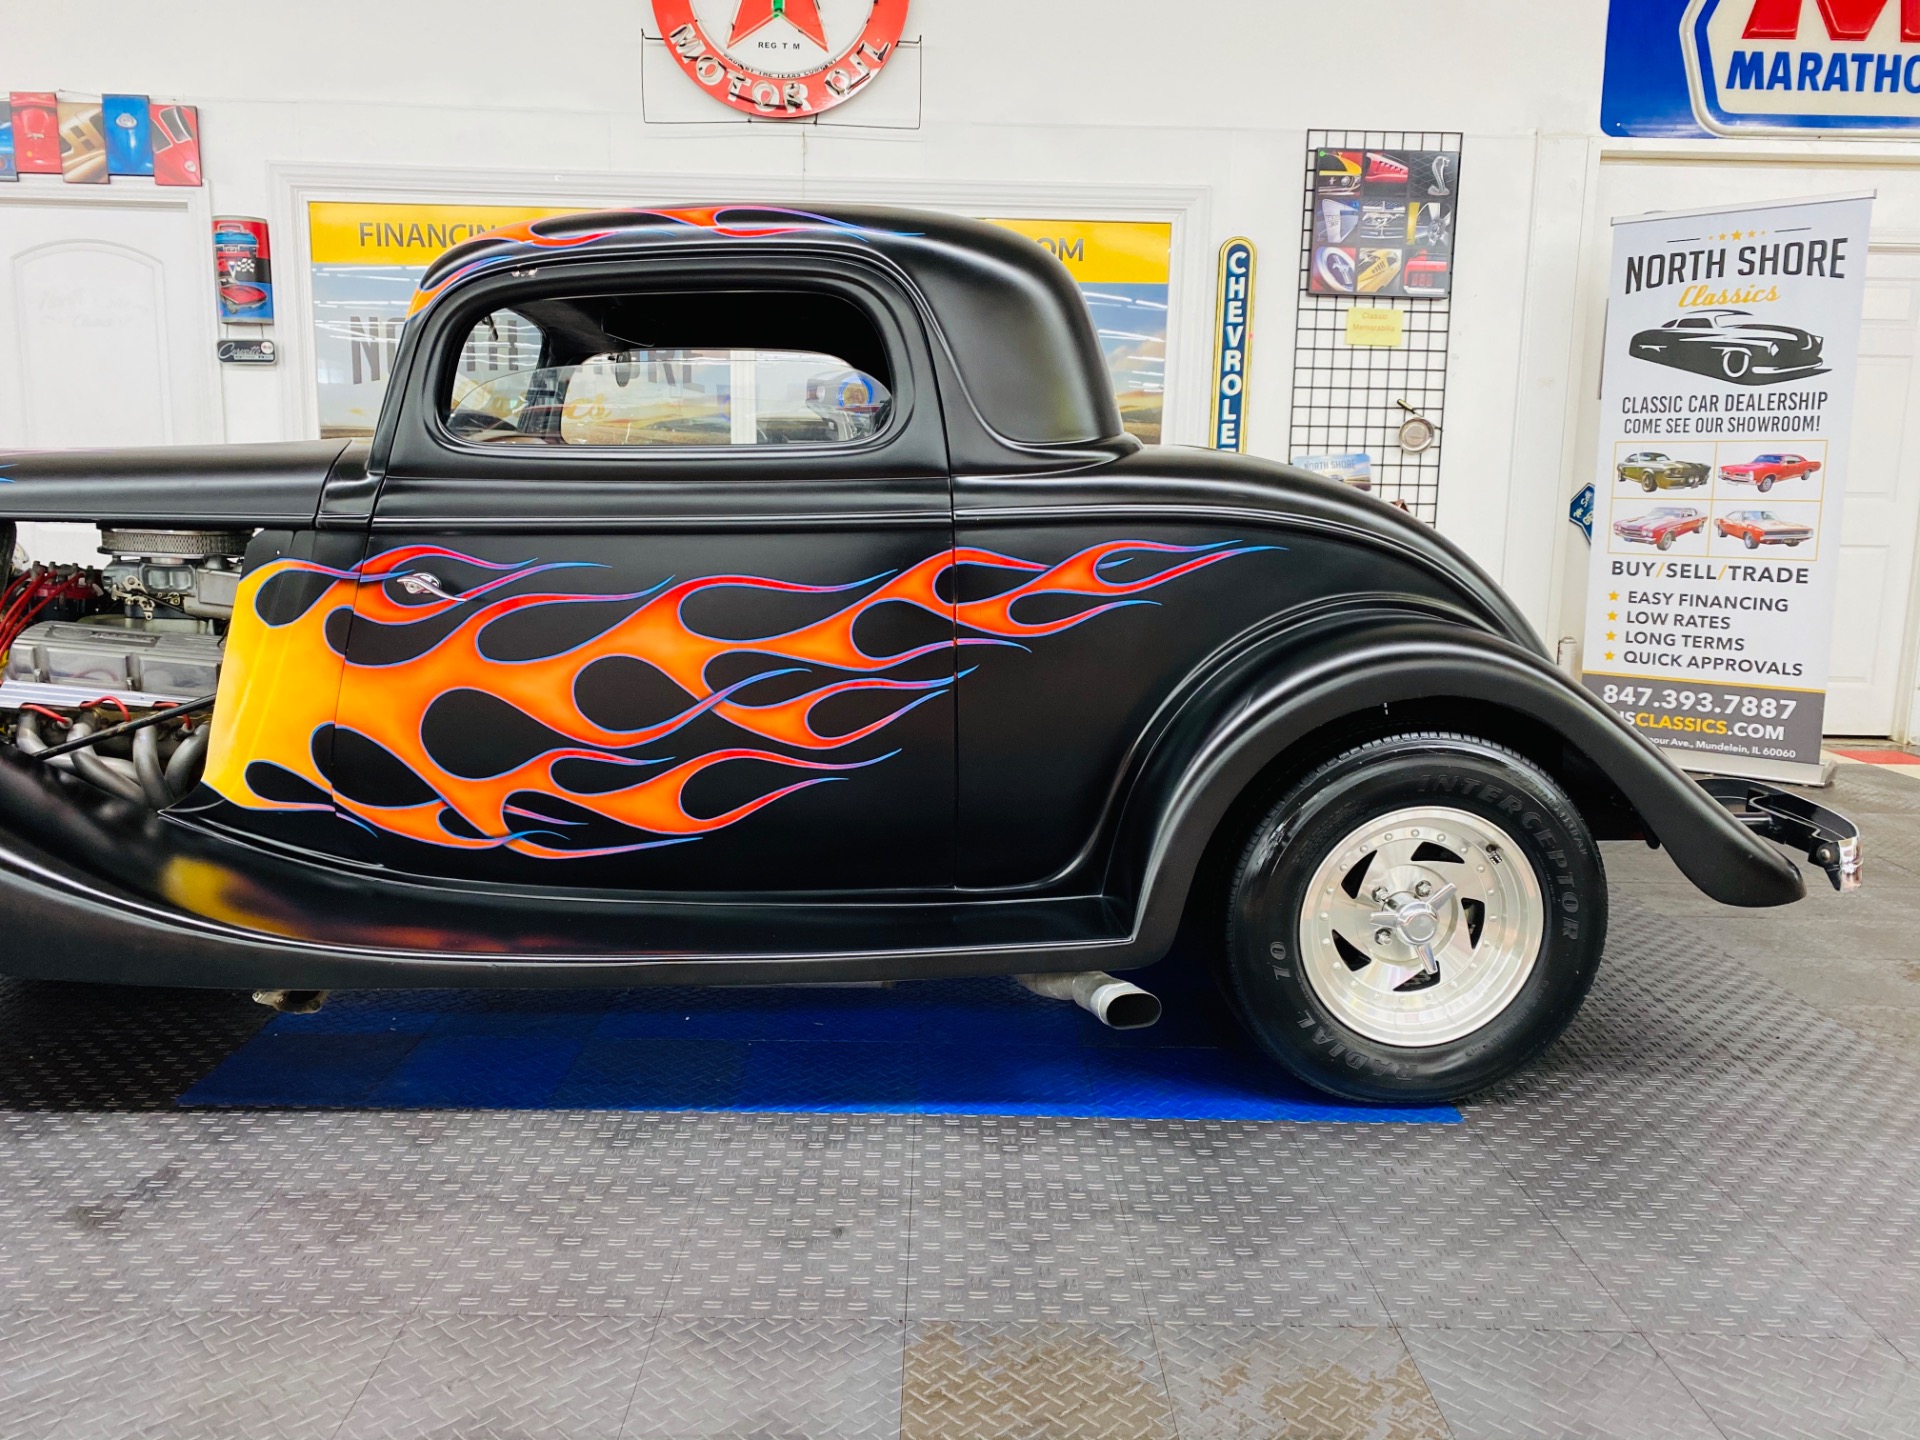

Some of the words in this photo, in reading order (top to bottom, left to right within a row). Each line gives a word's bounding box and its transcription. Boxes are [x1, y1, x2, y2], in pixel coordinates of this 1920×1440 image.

[757, 41, 777, 50] REG
[782, 42, 788, 50] T
[668, 24, 812, 113] MOTOR
[825, 40, 892, 98] OIL
[1725, 51, 1920, 94] MARATHO
[1625, 248, 1726, 294] NORTH
[1738, 237, 1849, 279] SHORE
[1677, 284, 1782, 308] Classics
[1219, 250, 1248, 452] CHEVROLE
[1622, 395, 1683, 414] CLASSIC
[1688, 394, 1719, 413] CAR
[1724, 391, 1829, 412] DEALERSHIP
[1624, 418, 1662, 434] COME
[1665, 417, 1691, 433] SEE
[1695, 417, 1724, 433] OUR
[1727, 415, 1821, 432] SHOWROOM!
[1611, 560, 1809, 584] BUY/SELL/TRADE
[1628, 591, 1674, 607] EASY
[1678, 593, 1789, 612] FINANCING
[1626, 611, 1668, 626] LOW
[1673, 613, 1731, 630] RATES
[1625, 631, 1676, 647] LONG
[1681, 634, 1745, 651] TERMS
[1623, 650, 1682, 668] QUICK
[1686, 655, 1803, 676] APPROVALS
[1603, 684, 1797, 720] 847.393.7887
[1695, 740, 1750, 754] Mundelein,
[1752, 746, 1762, 754] IL
[1763, 747, 1797, 759] 60060
[1418, 774, 1580, 940] INTERCEPTOR
[1297, 1008, 1419, 1082] RADIAL
